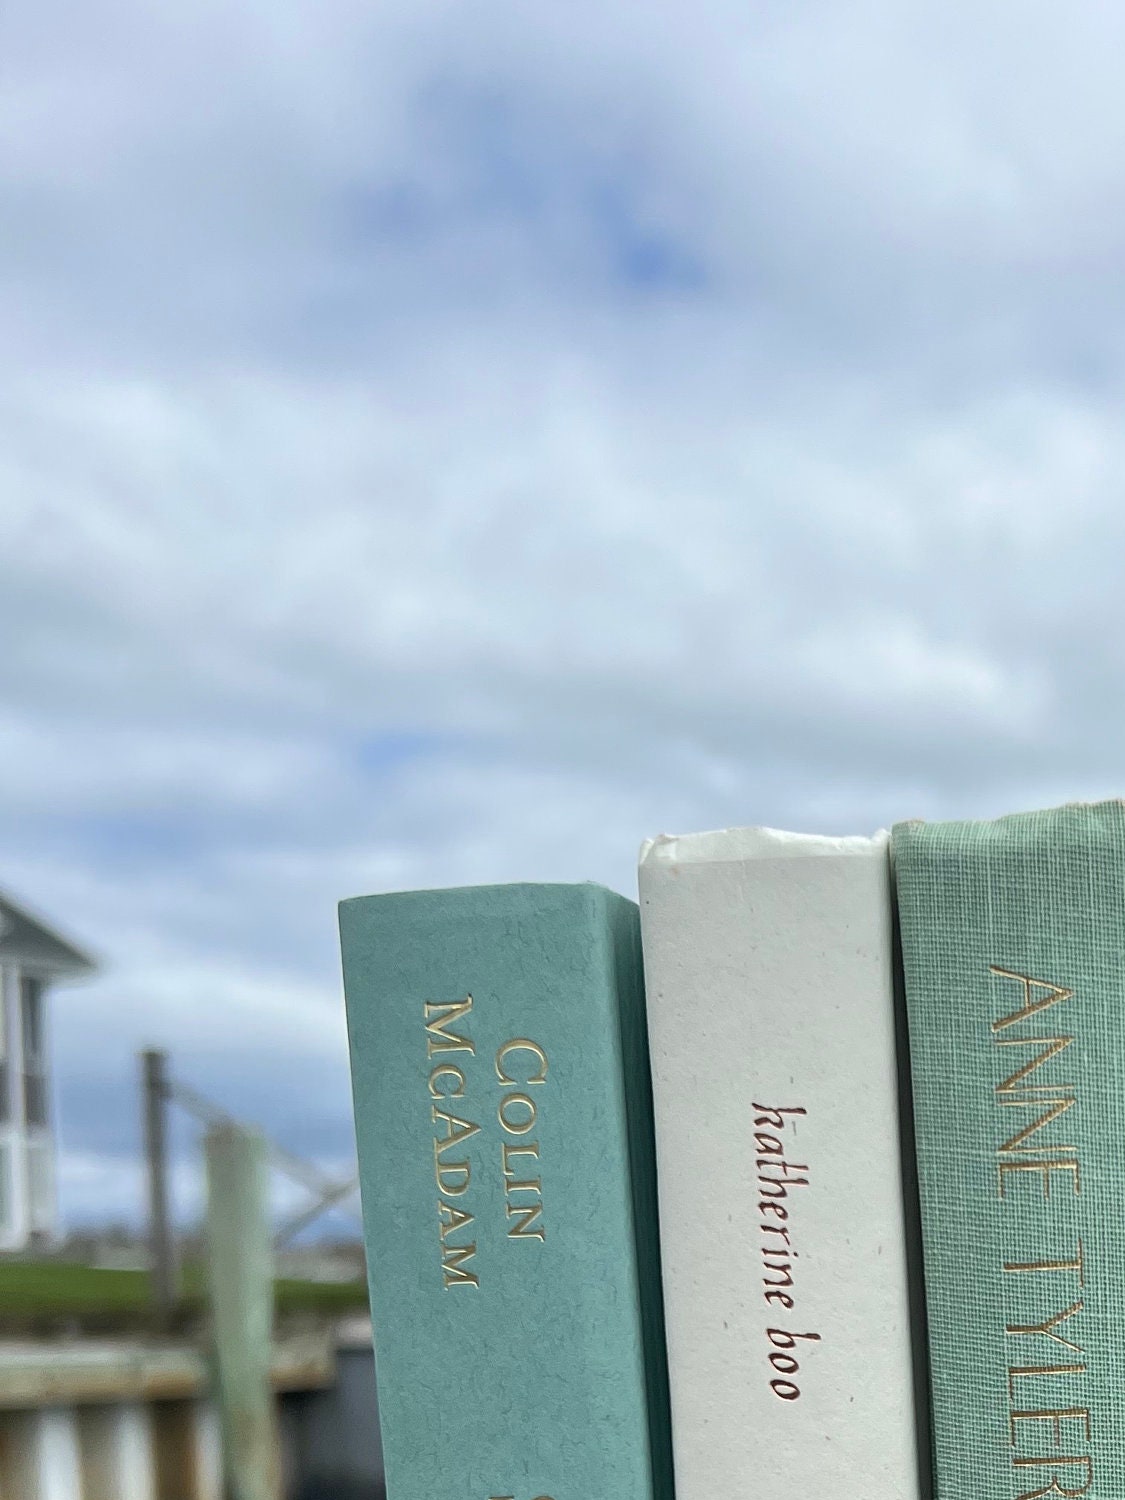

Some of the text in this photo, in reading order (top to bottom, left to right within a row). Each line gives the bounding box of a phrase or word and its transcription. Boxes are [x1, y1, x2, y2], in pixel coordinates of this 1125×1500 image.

[989, 964, 1081, 1199] ANNE
[751, 1102, 810, 1310] katherine
[766, 1327, 822, 1402] boo
